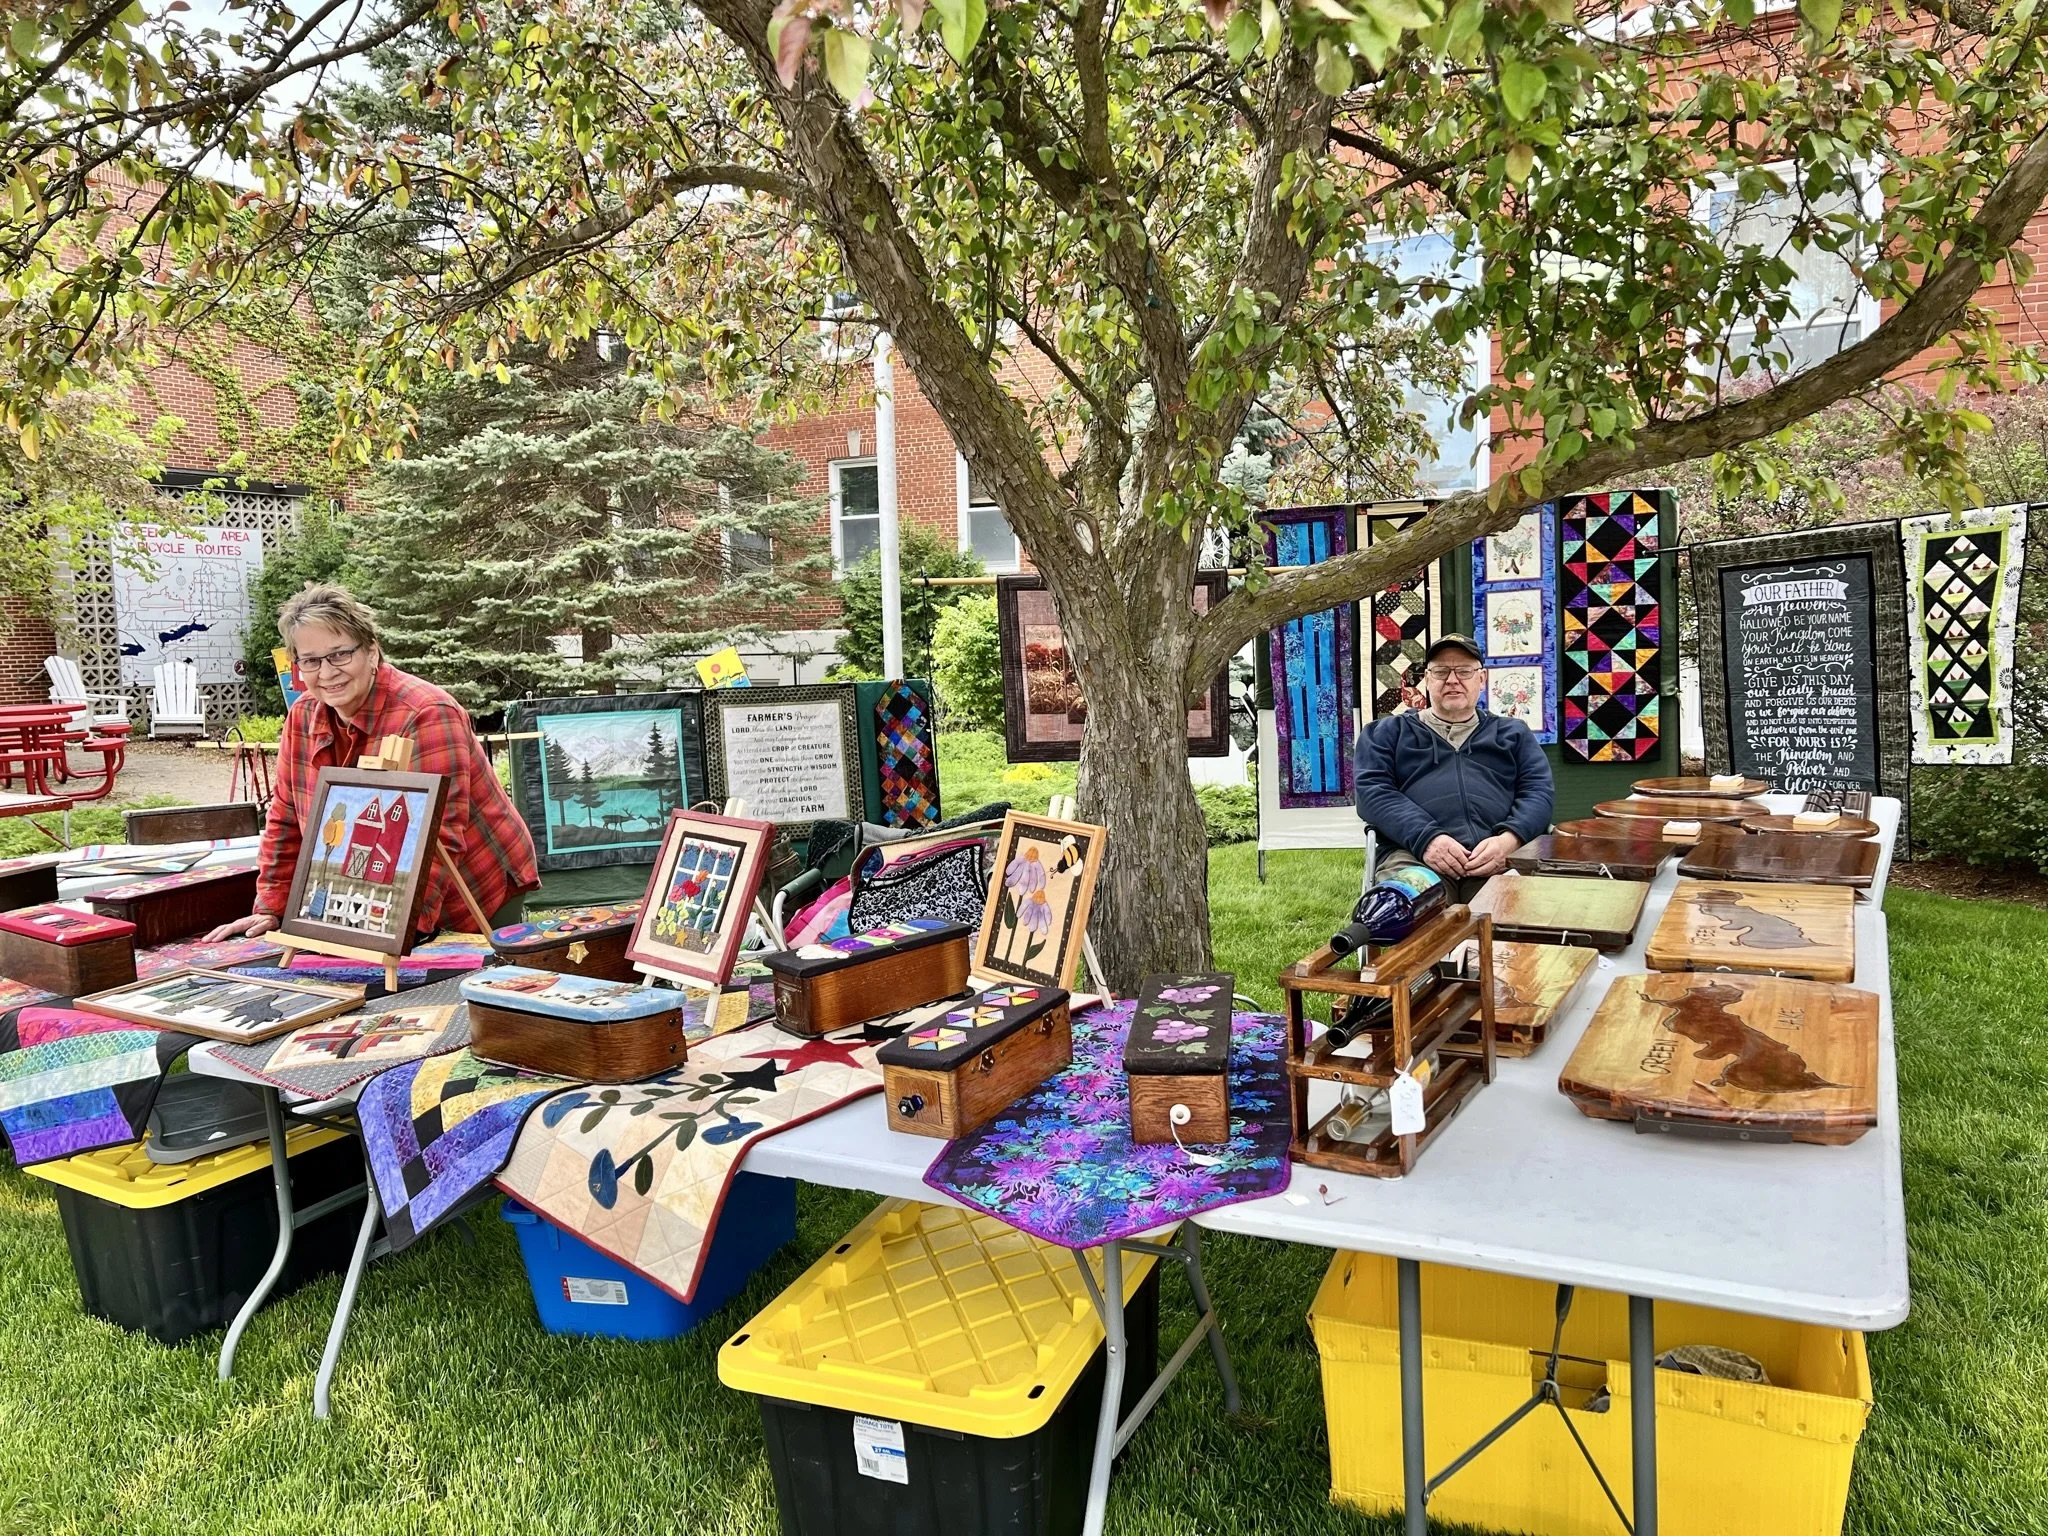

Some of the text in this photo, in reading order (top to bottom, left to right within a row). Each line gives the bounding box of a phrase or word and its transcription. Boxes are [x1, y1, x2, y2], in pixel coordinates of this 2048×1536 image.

[221, 532, 250, 542] AREA
[196, 544, 241, 555] ROUTES
[1755, 582, 1834, 601] OUR FATHER
[1740, 612, 1853, 630] HALLOWED BE YOUR NAME
[1741, 625, 1853, 647] YOUR Kingdom COME
[1776, 642, 1804, 654] will
[1807, 641, 1820, 653] be
[1824, 640, 1853, 652] done
[1743, 657, 1752, 666] ON
[1755, 657, 1778, 666] EARTH
[1748, 674, 1850, 688] GIVE US THIS DAY
[1744, 684, 1856, 699] our daily bread
[1745, 700, 1761, 708] AND
[1766, 698, 1804, 706] FORGIVE
[1834, 697, 1857, 705] DEBTS
[748, 713, 792, 722] FARMER'S
[1745, 709, 1756, 717] as
[1777, 706, 1810, 719] forgive
[1799, 726, 1817, 735] from
[1768, 737, 1790, 748] FOR
[1794, 737, 1826, 748] YOURS
[1755, 748, 1854, 766] THE Kingdom AND
[1758, 760, 1850, 777] THE Power AND
[801, 804, 825, 813] FARM
[1773, 1007, 1806, 1031] LAKE
[1639, 1038, 1680, 1075] GREEN
